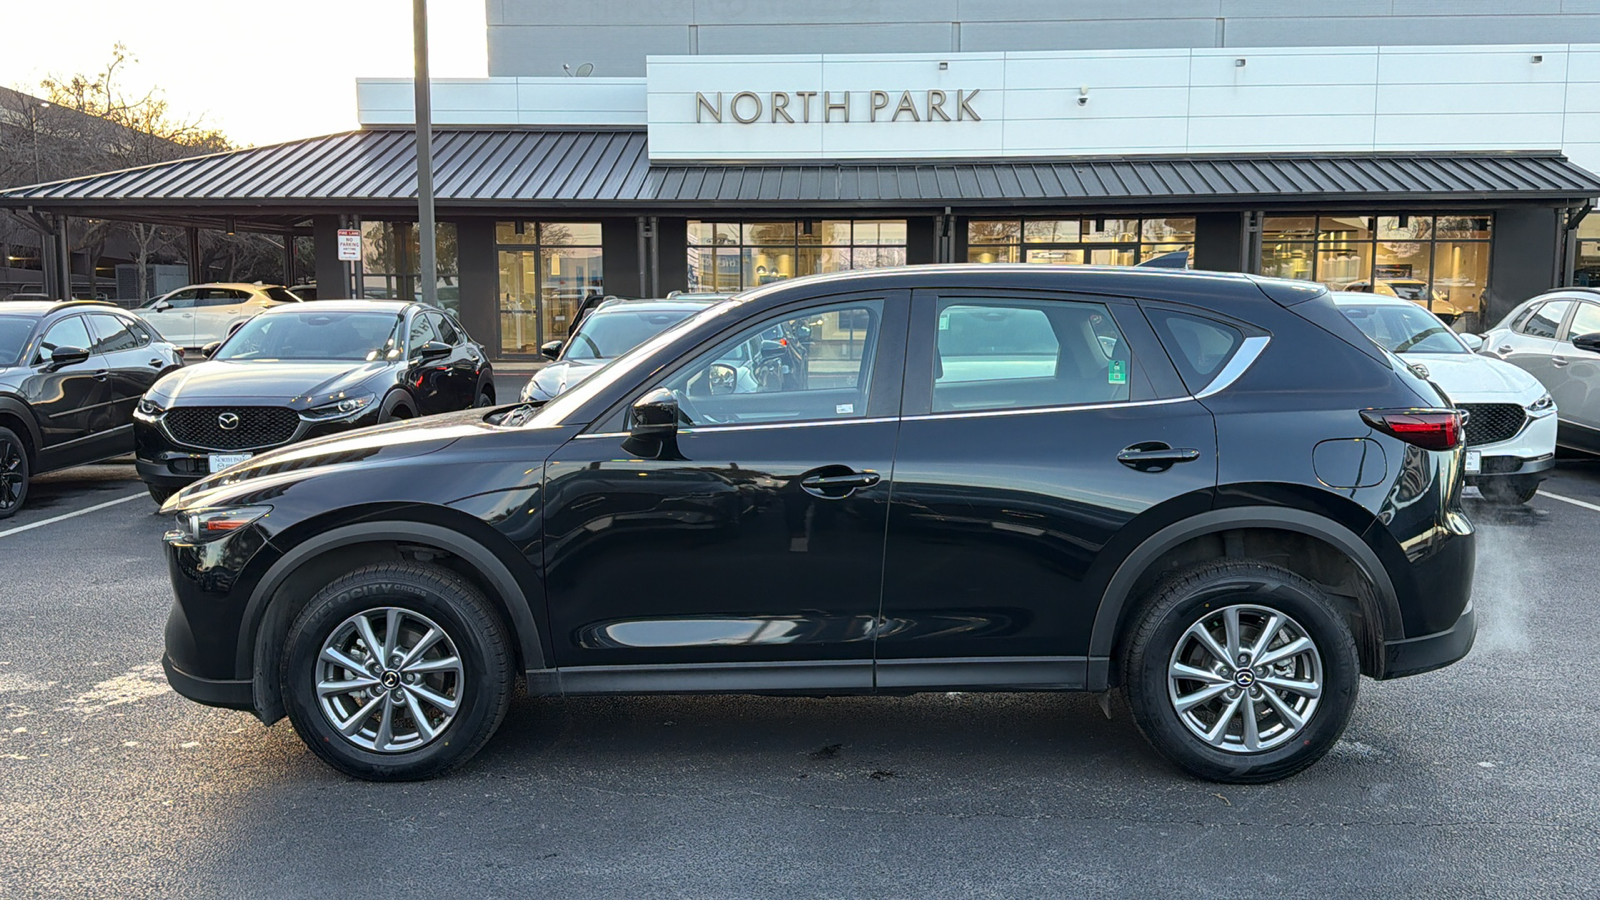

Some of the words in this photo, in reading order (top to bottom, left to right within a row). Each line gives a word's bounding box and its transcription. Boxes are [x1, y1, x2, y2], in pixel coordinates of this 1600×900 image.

[696, 91, 850, 124] NORTH
[870, 89, 982, 122] PARK
[310, 583, 392, 623] VELOCITY
[394, 584, 427, 597] CROSS
